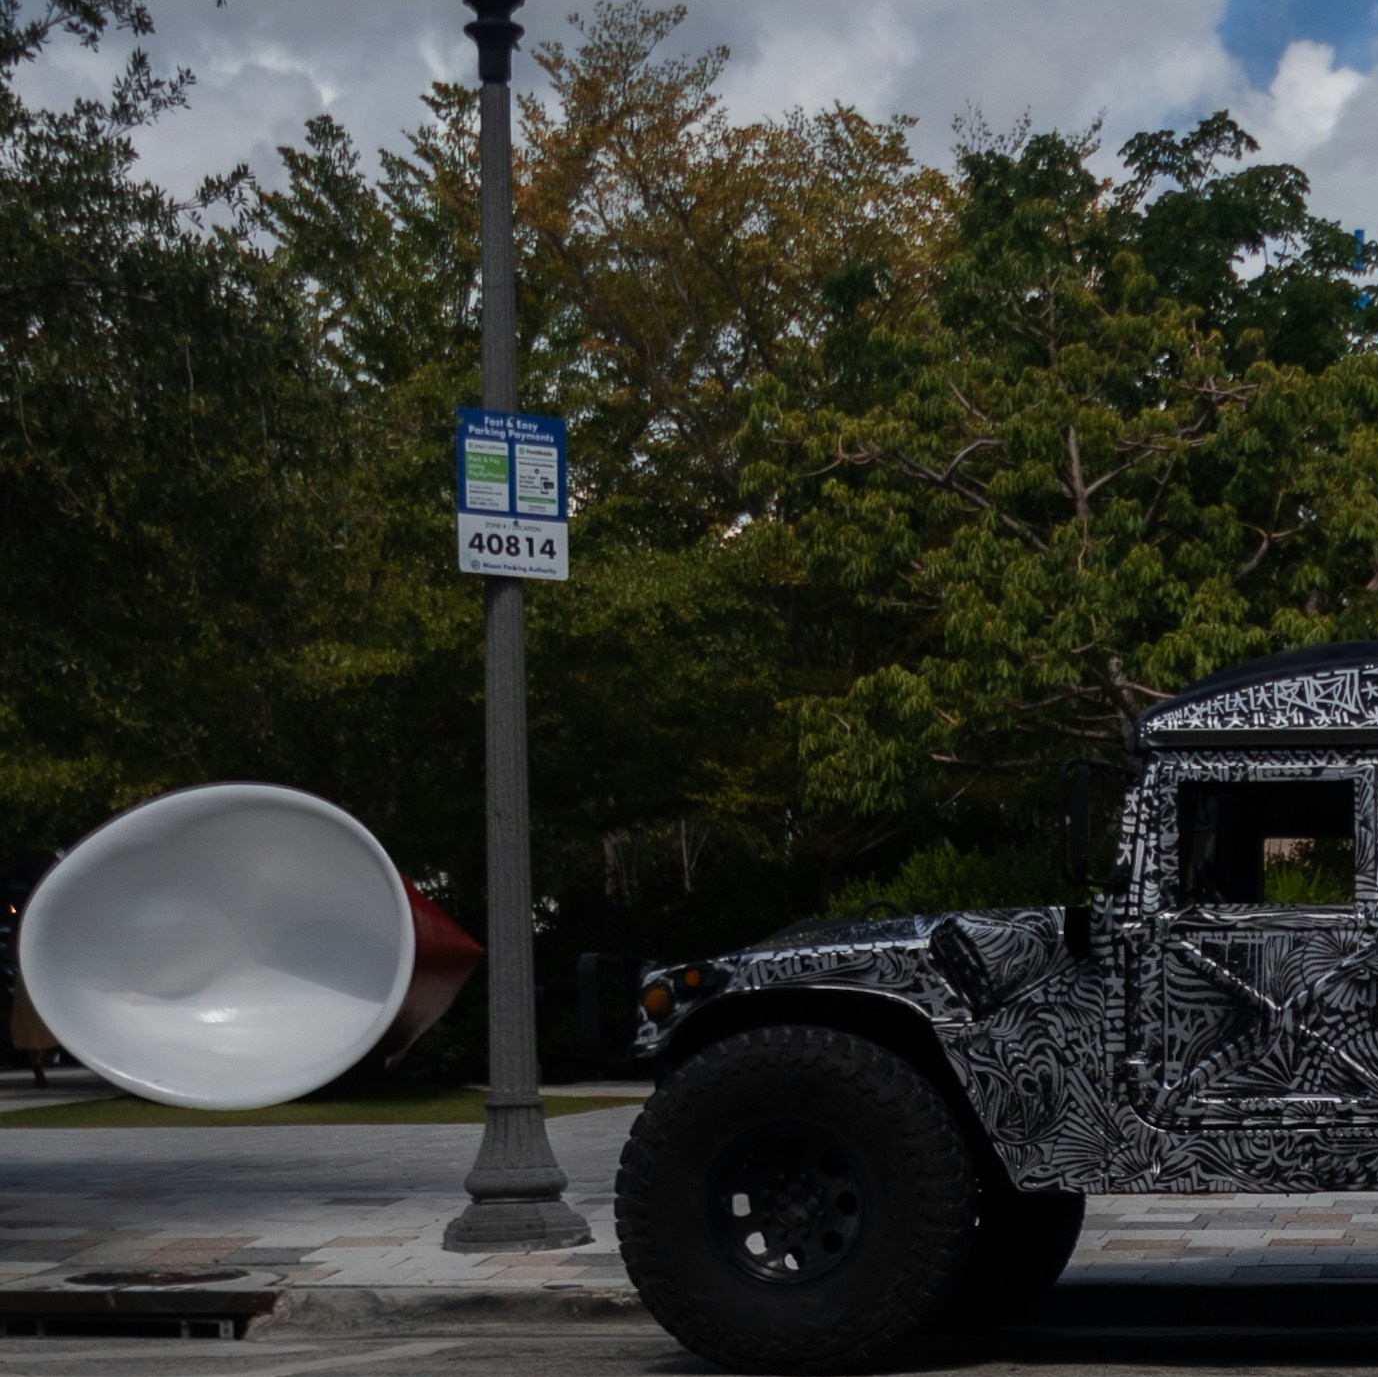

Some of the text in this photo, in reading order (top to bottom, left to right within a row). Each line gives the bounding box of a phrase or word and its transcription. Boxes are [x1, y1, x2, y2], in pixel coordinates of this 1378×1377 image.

[468, 424, 555, 443] Parking Payments
[484, 416, 539, 433] Fast & Easy
[468, 532, 557, 560] 40814
[503, 563, 527, 573] Parking
[528, 565, 557, 575] Authority
